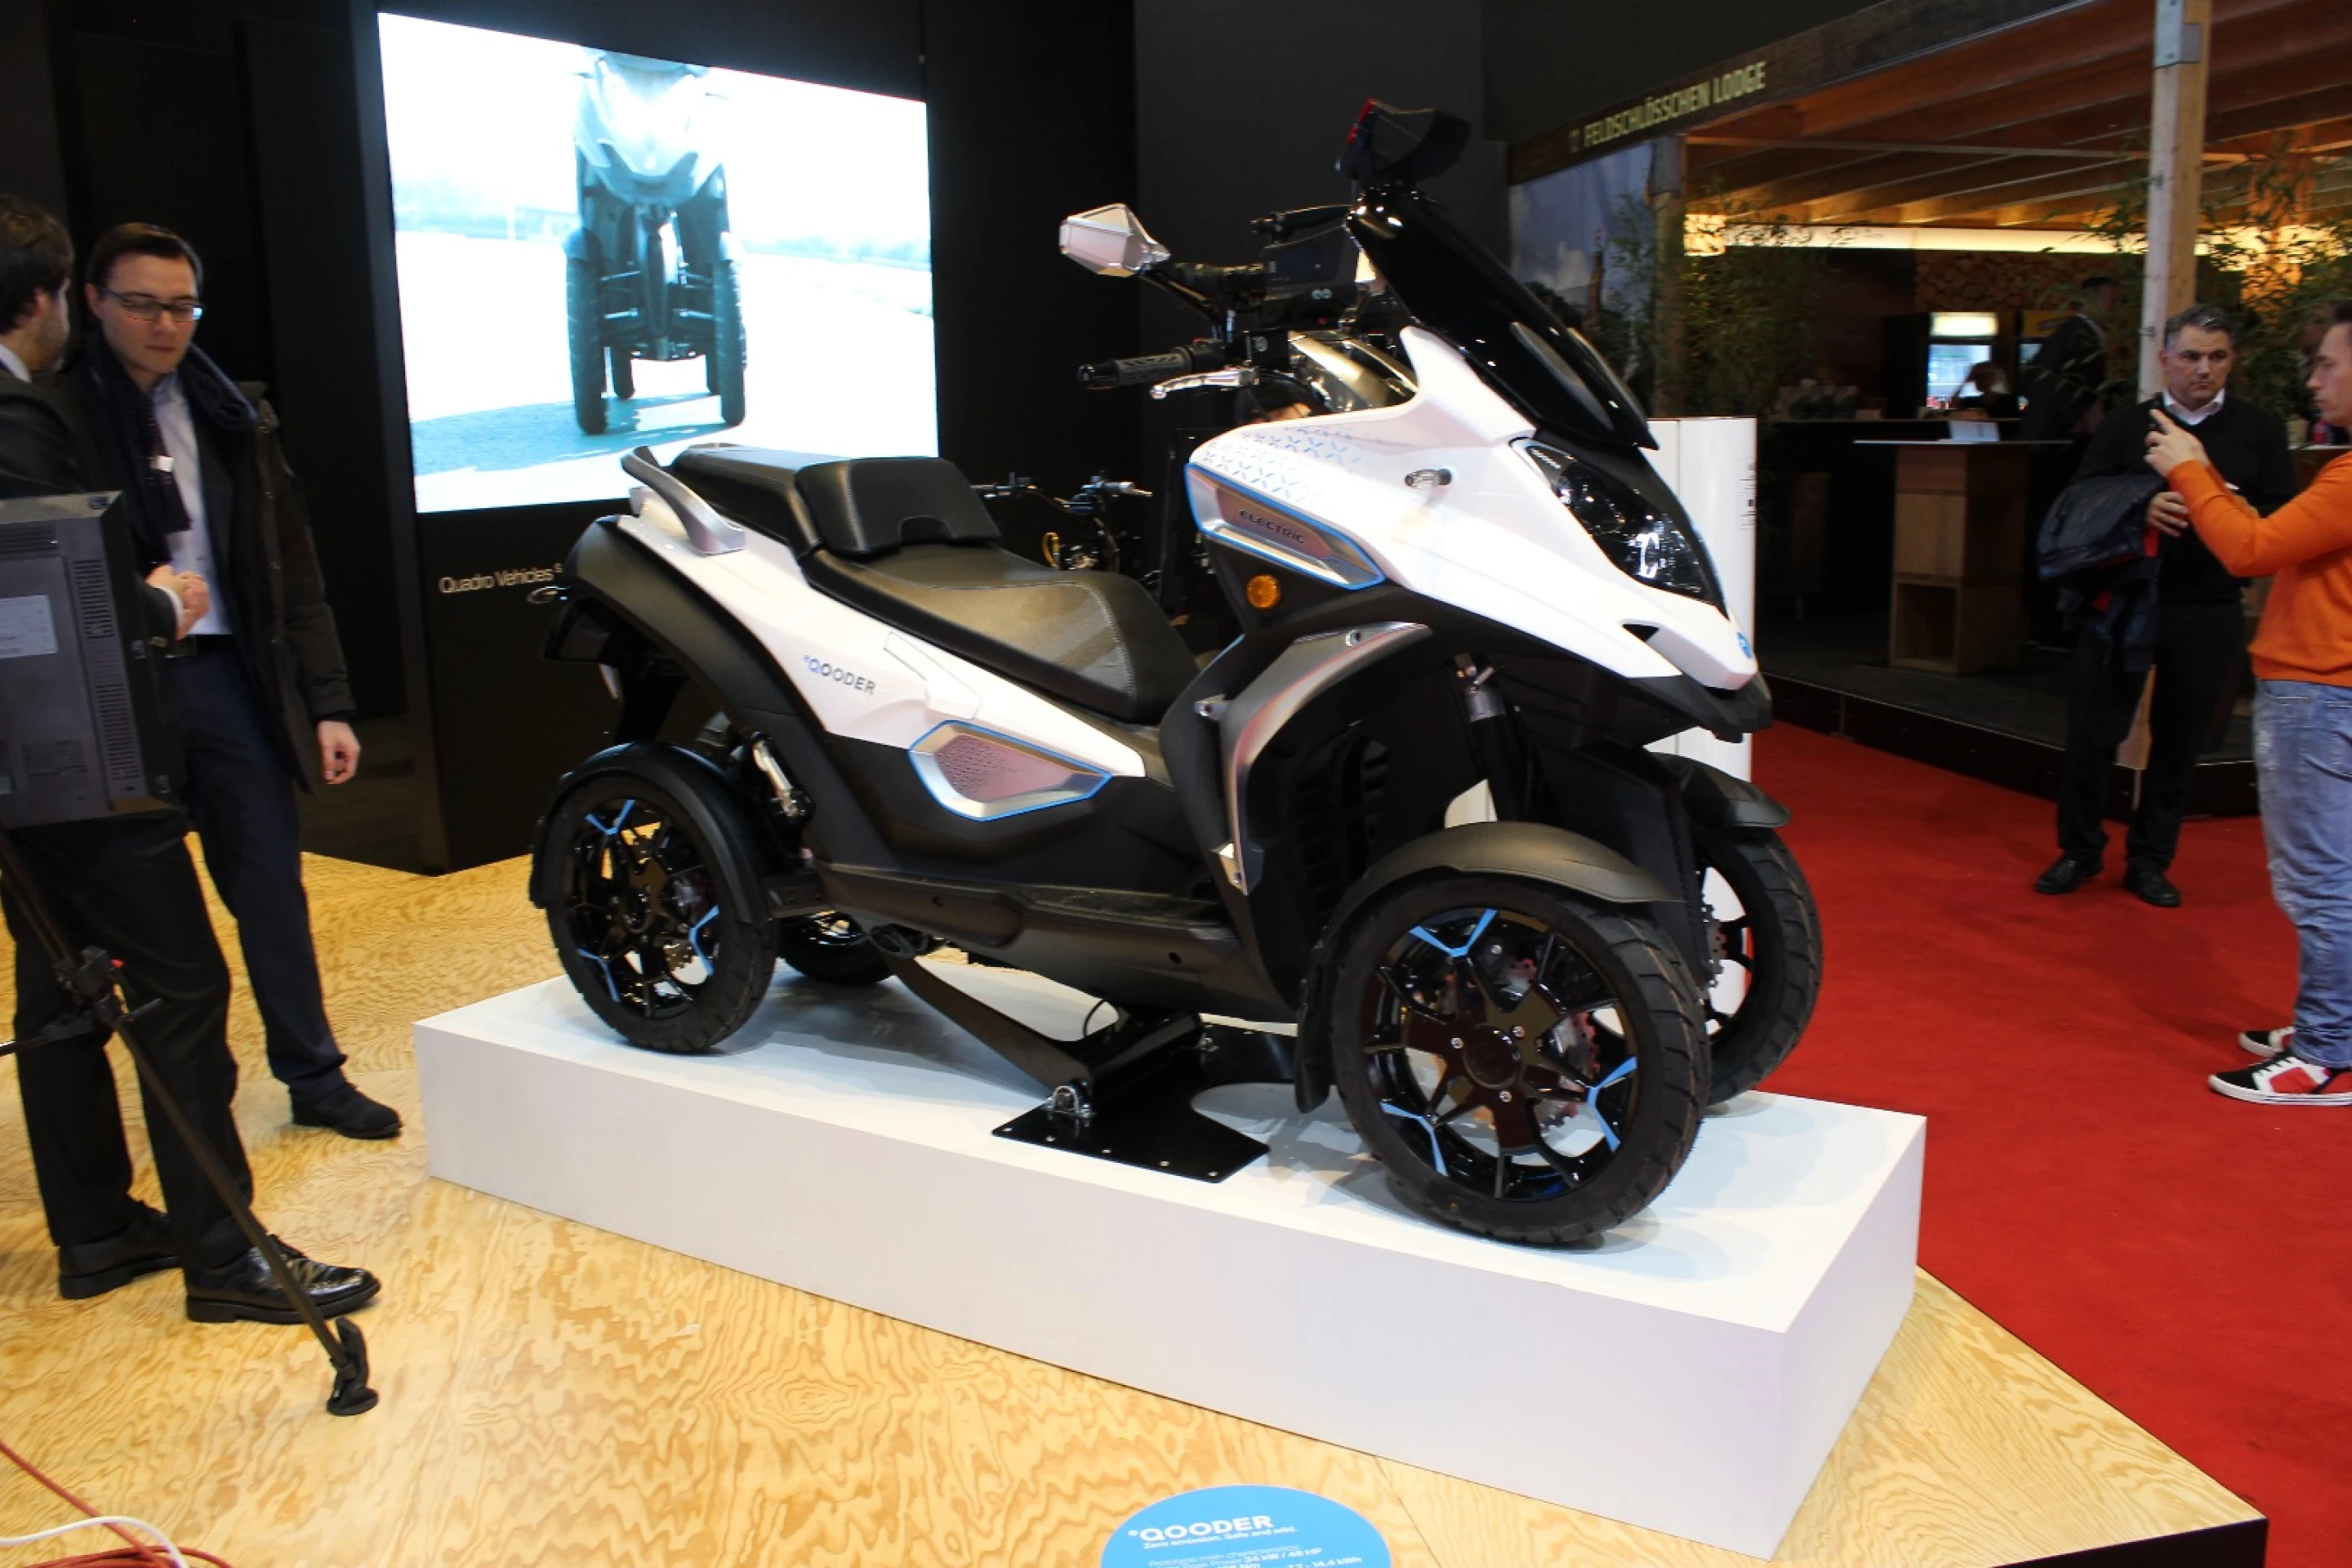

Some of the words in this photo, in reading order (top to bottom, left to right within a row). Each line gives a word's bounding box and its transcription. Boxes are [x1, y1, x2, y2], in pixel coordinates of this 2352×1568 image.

[1583, 82, 1711, 148] FELDSCHLÖSSCHEN
[1713, 60, 1766, 104] LODGE
[1239, 510, 1305, 544] ELECTRIC
[438, 572, 495, 594] Quadro
[494, 567, 555, 586] Vehicles
